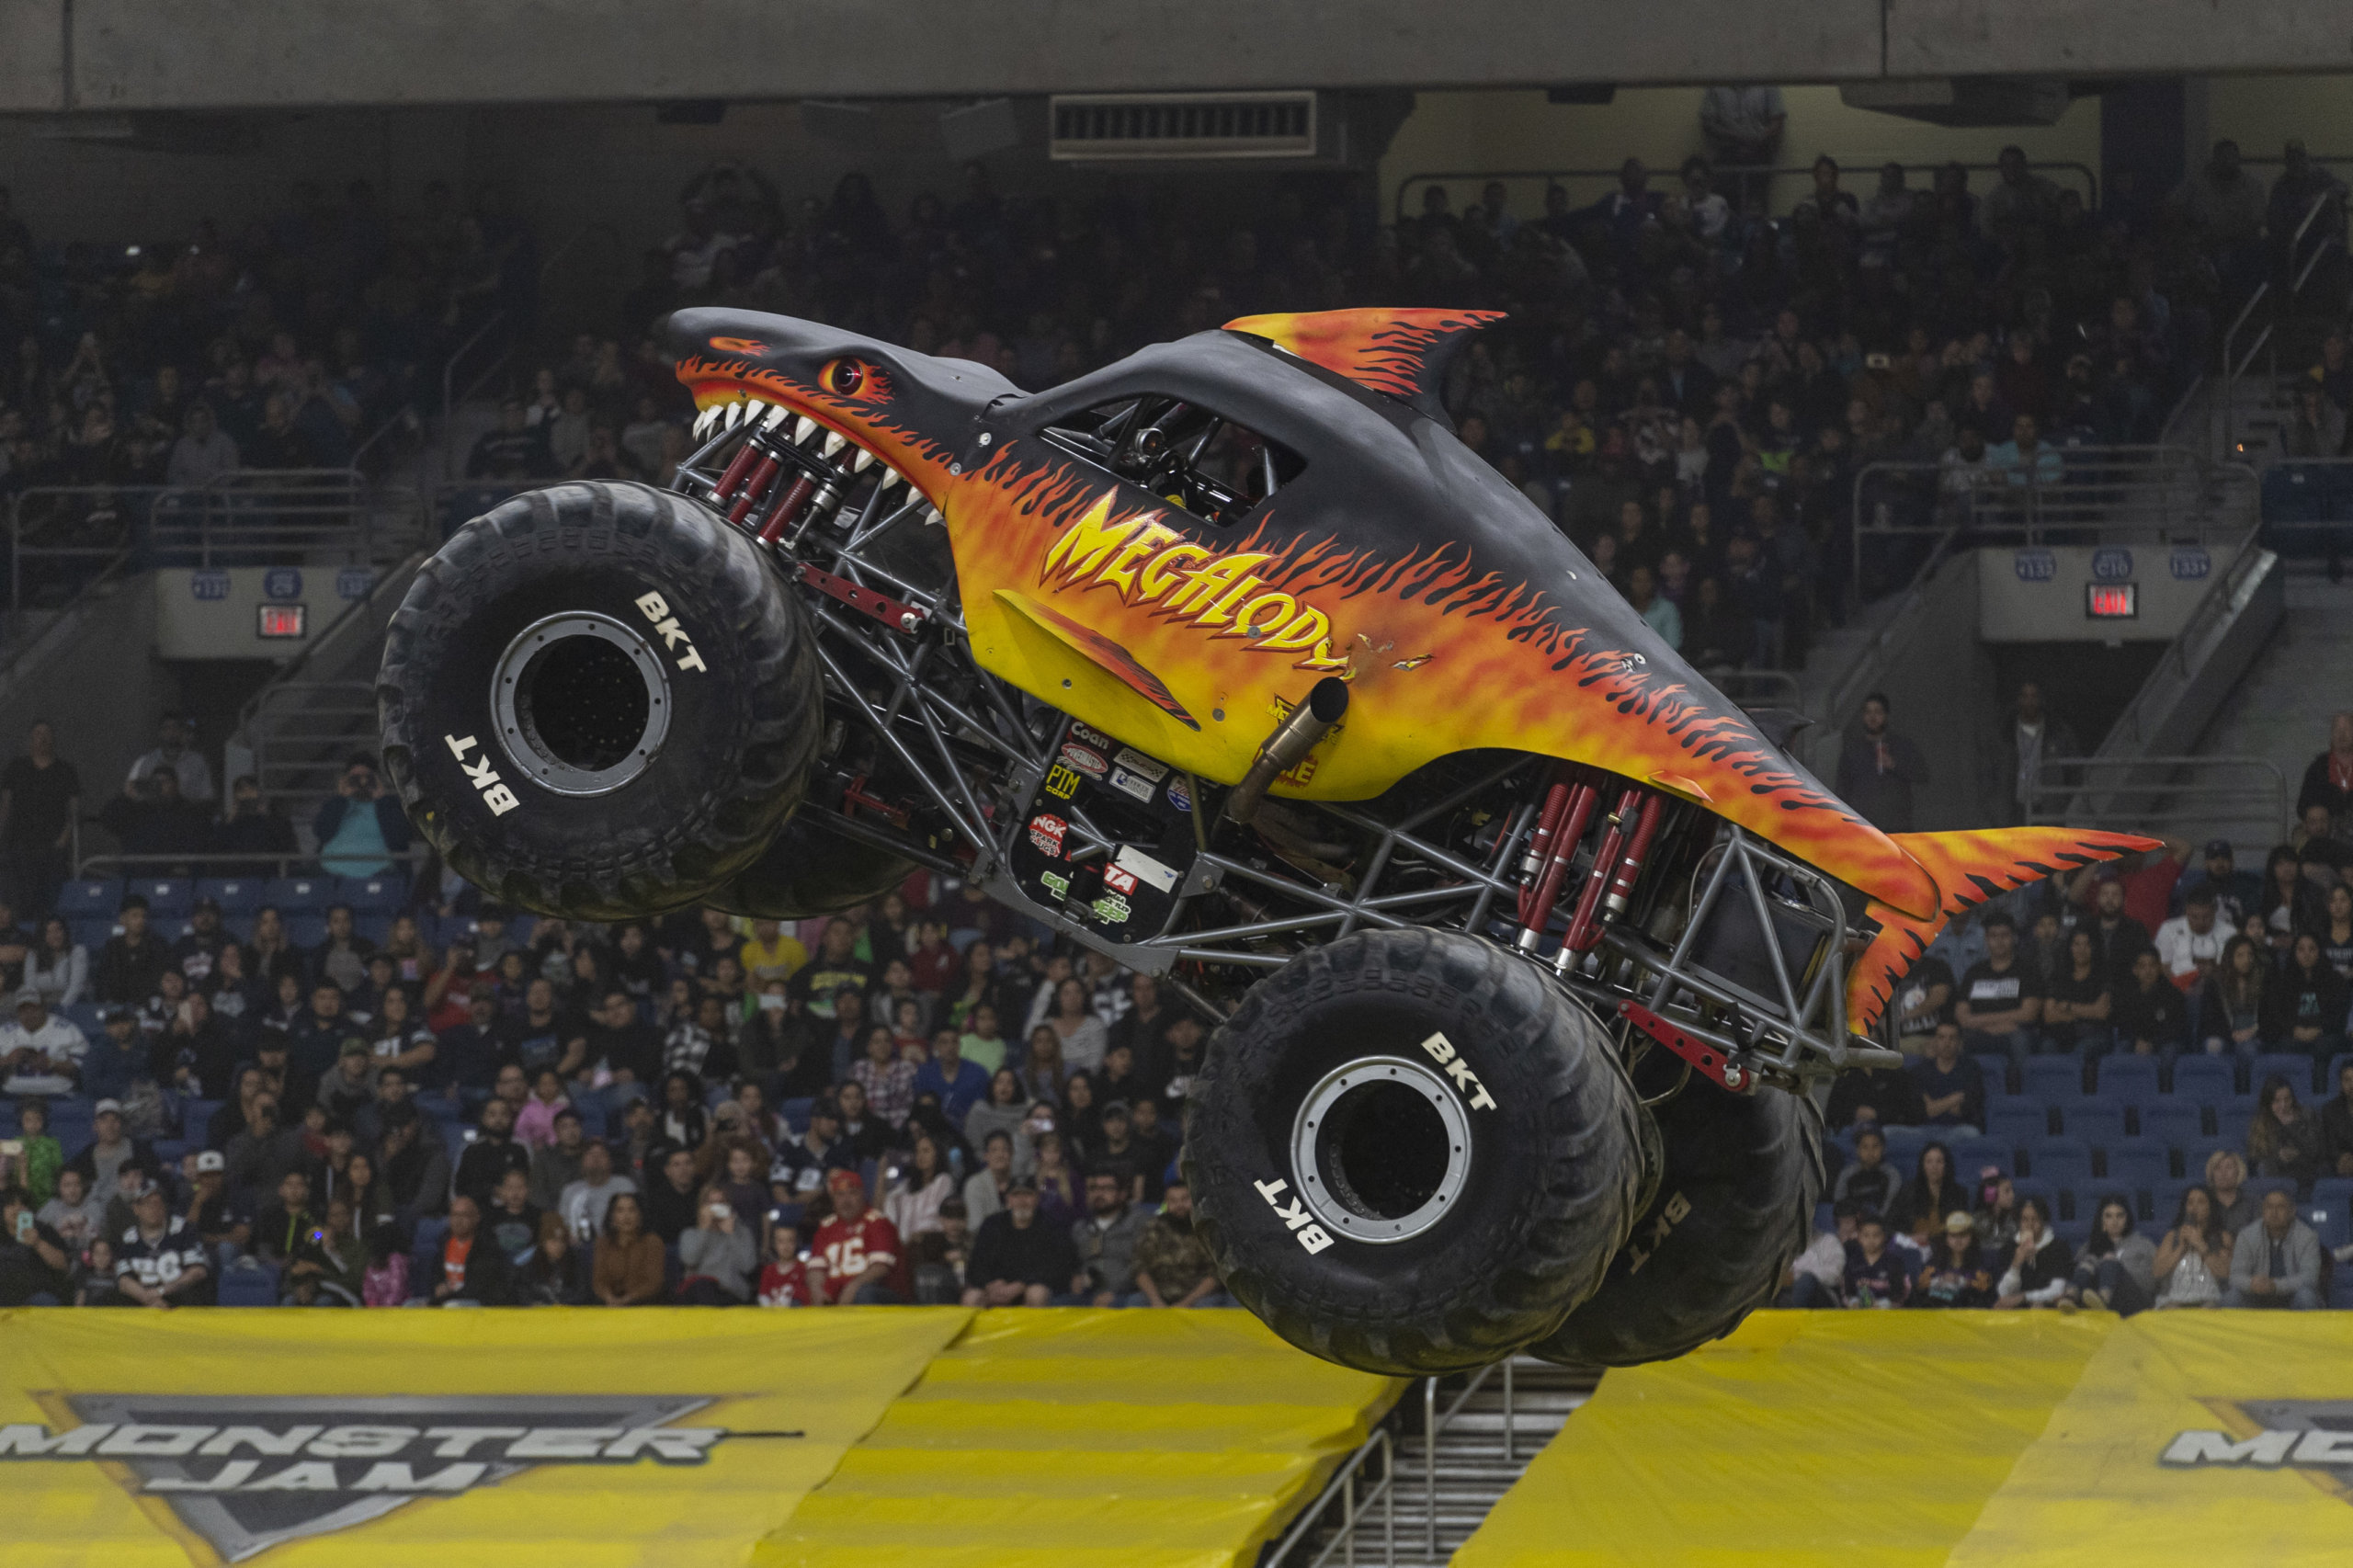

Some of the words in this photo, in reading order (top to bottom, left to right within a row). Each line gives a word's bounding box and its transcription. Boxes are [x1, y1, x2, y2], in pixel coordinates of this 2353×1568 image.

[634, 590, 707, 673] BKT
[1071, 721, 1108, 750] Coan
[444, 734, 520, 816] BKT
[1045, 785, 1074, 801] CORP
[1046, 764, 1081, 797] PTM
[1029, 830, 1059, 848] SPARK
[1033, 816, 1067, 838] NGK
[1421, 1030, 1497, 1112] BKT
[1254, 1177, 1335, 1256] BKT
[1630, 1190, 1691, 1275] BKT
[825, 1236, 867, 1278] 16
[0, 1424, 724, 1460] MONSTER
[144, 1460, 488, 1492] JAM
